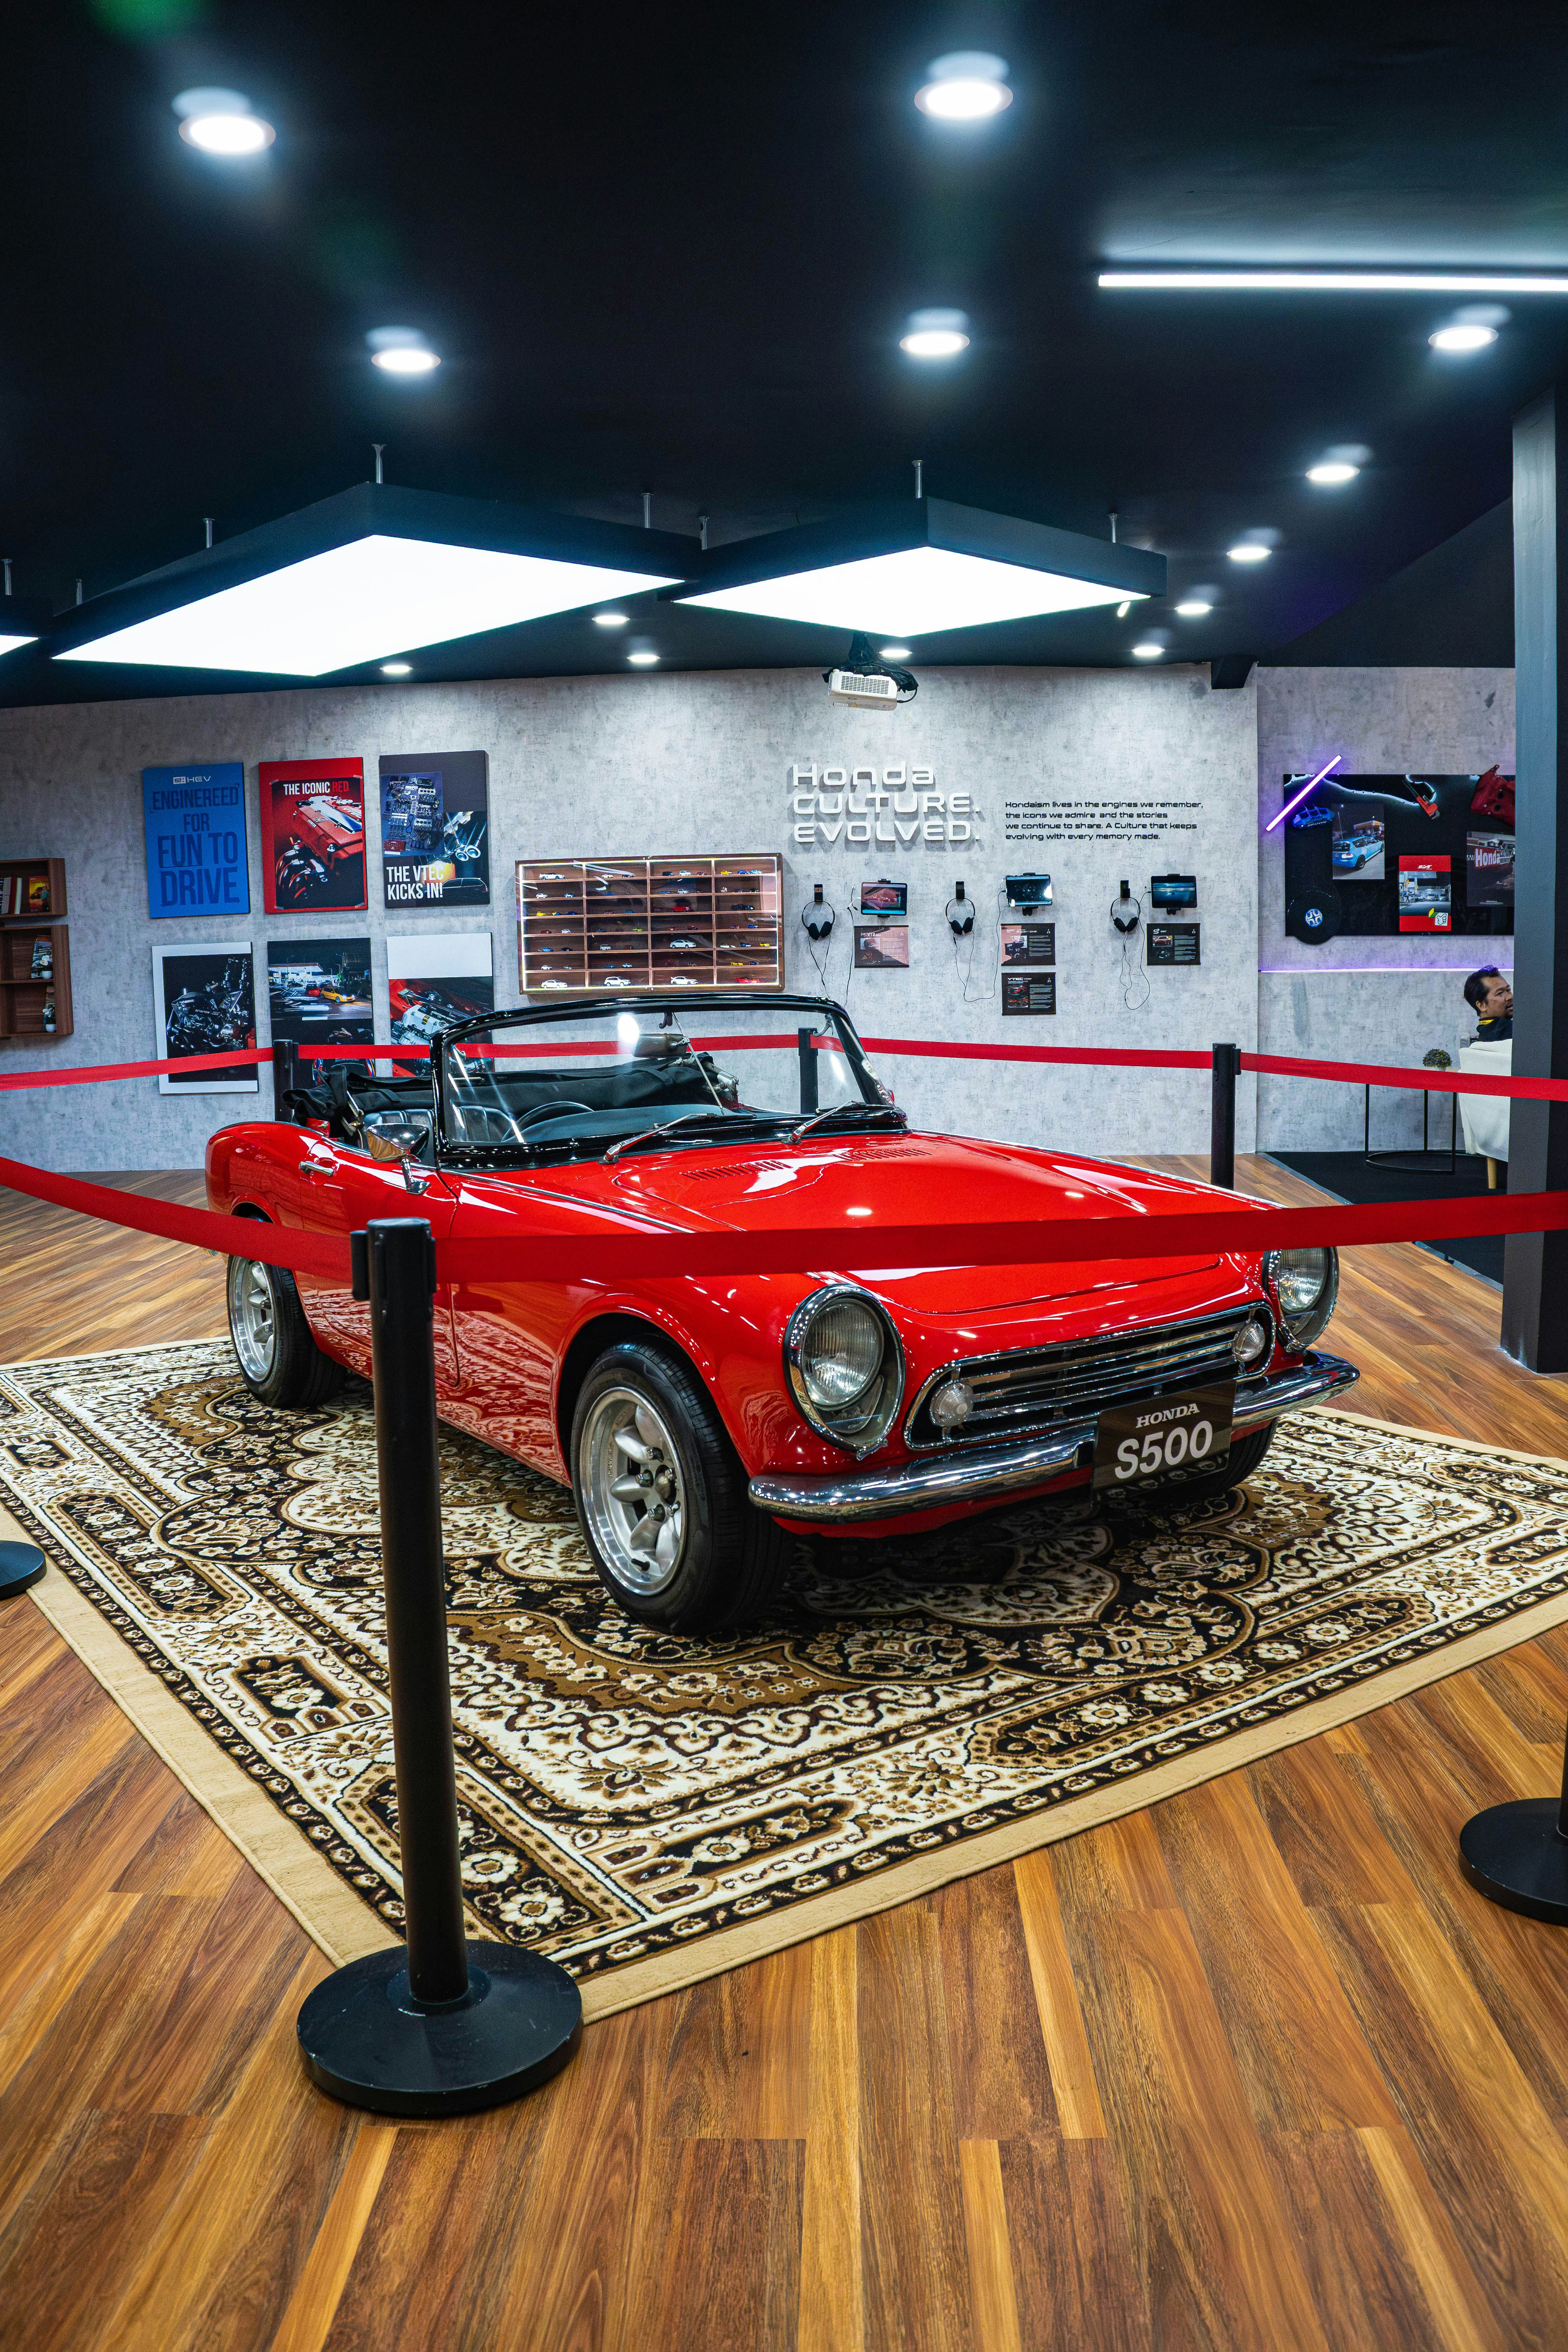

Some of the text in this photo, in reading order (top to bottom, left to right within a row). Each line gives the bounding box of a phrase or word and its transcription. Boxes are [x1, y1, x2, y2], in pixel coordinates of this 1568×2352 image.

[793, 761, 935, 786] Honda
[152, 786, 239, 810] ENGINEREED
[283, 781, 349, 795] THE ICONIC RED
[793, 792, 980, 814] CULTURE.
[183, 813, 210, 833] FOR
[794, 821, 980, 842] EVOLVED.
[158, 831, 238, 867] FUN TO
[1475, 848, 1500, 867] Honda
[386, 865, 443, 882] THE VTEC
[160, 867, 240, 906] DRIVE
[388, 882, 443, 900] KICKS IN!
[1136, 1403, 1200, 1428] HONDA
[1115, 1421, 1212, 1479] S500
